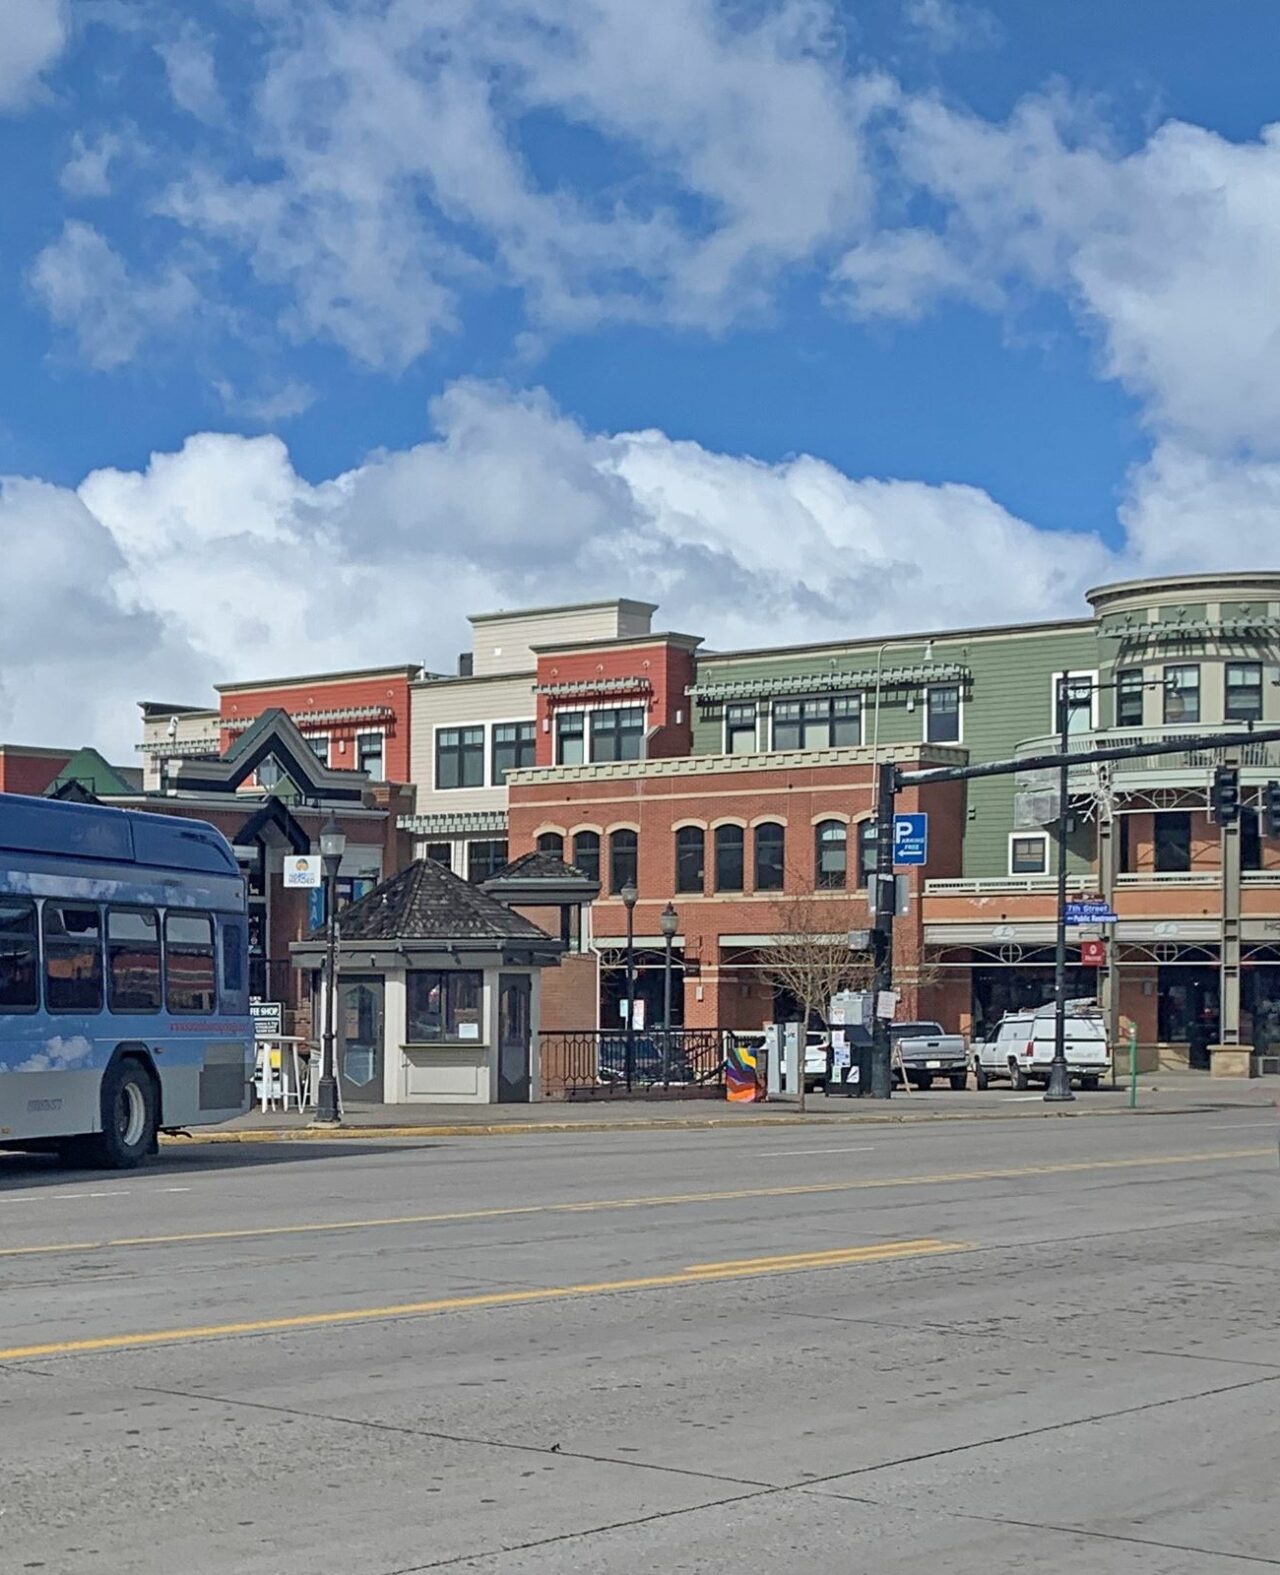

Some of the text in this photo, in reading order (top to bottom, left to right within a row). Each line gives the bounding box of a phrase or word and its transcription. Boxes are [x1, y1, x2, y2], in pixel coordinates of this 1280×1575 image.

[1067, 904, 1108, 913] 7th Street
[1073, 914, 1090, 922] Public
[261, 1007, 278, 1016] SHOP
